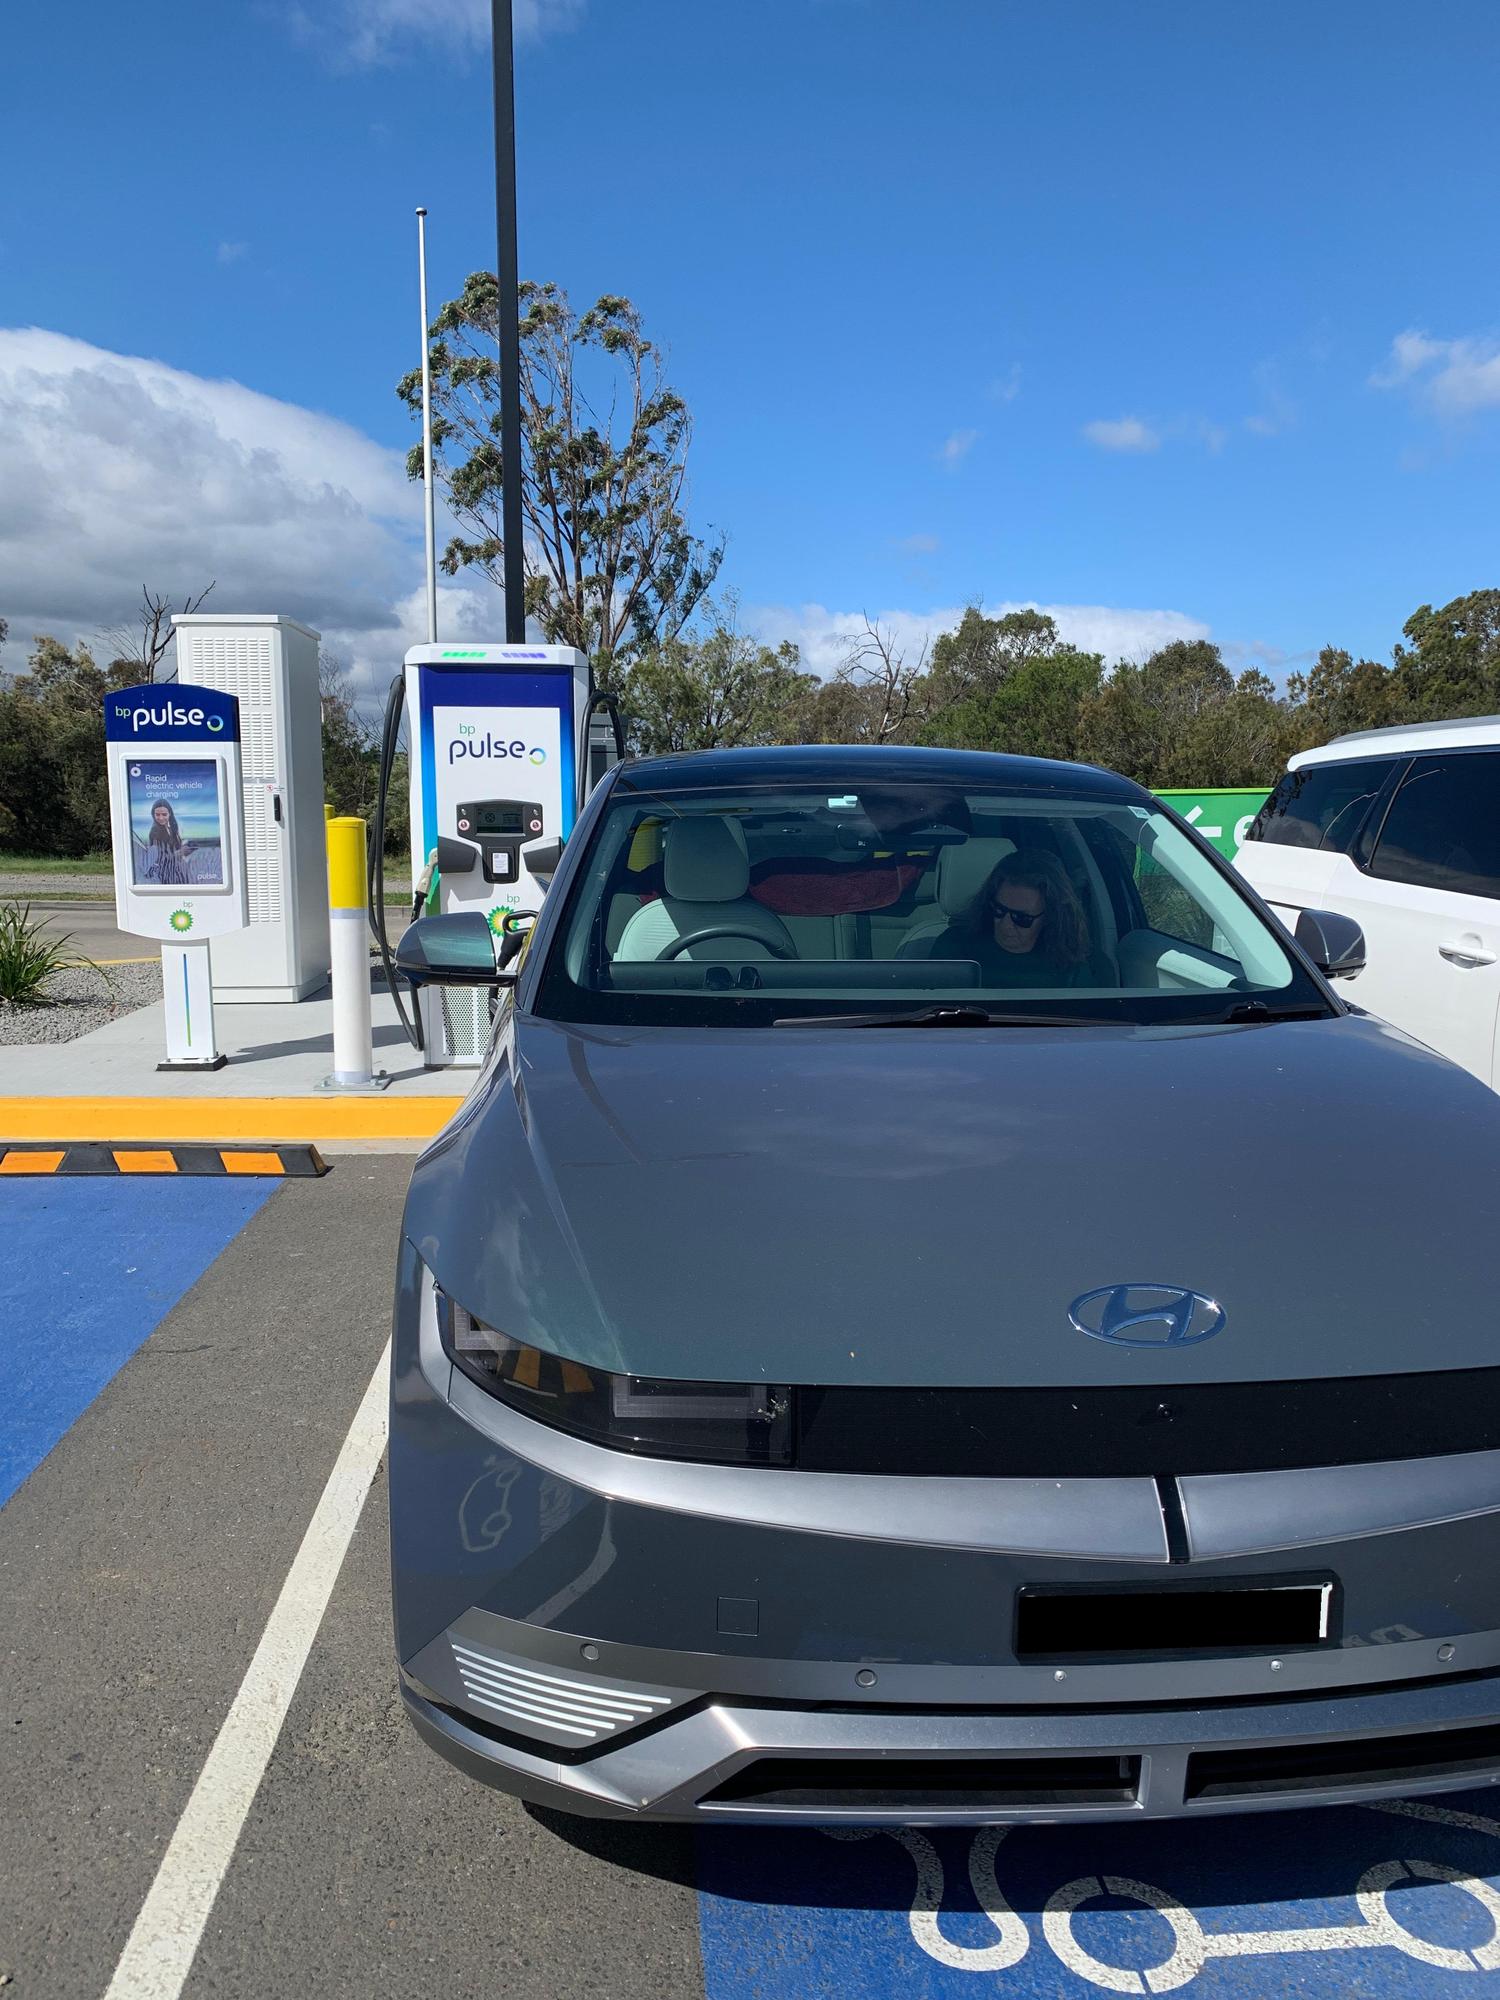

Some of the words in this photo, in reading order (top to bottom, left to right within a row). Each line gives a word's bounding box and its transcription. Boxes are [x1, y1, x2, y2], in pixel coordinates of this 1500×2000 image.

[115, 705, 131, 719] bp
[133, 701, 205, 732] pulse
[459, 723, 476, 737] bp
[449, 732, 526, 765] pulse
[145, 774, 168, 784] Rapid
[145, 782, 174, 790] electric
[175, 781, 203, 789] vehicle
[146, 790, 179, 798] charging
[507, 893, 520, 905] bp
